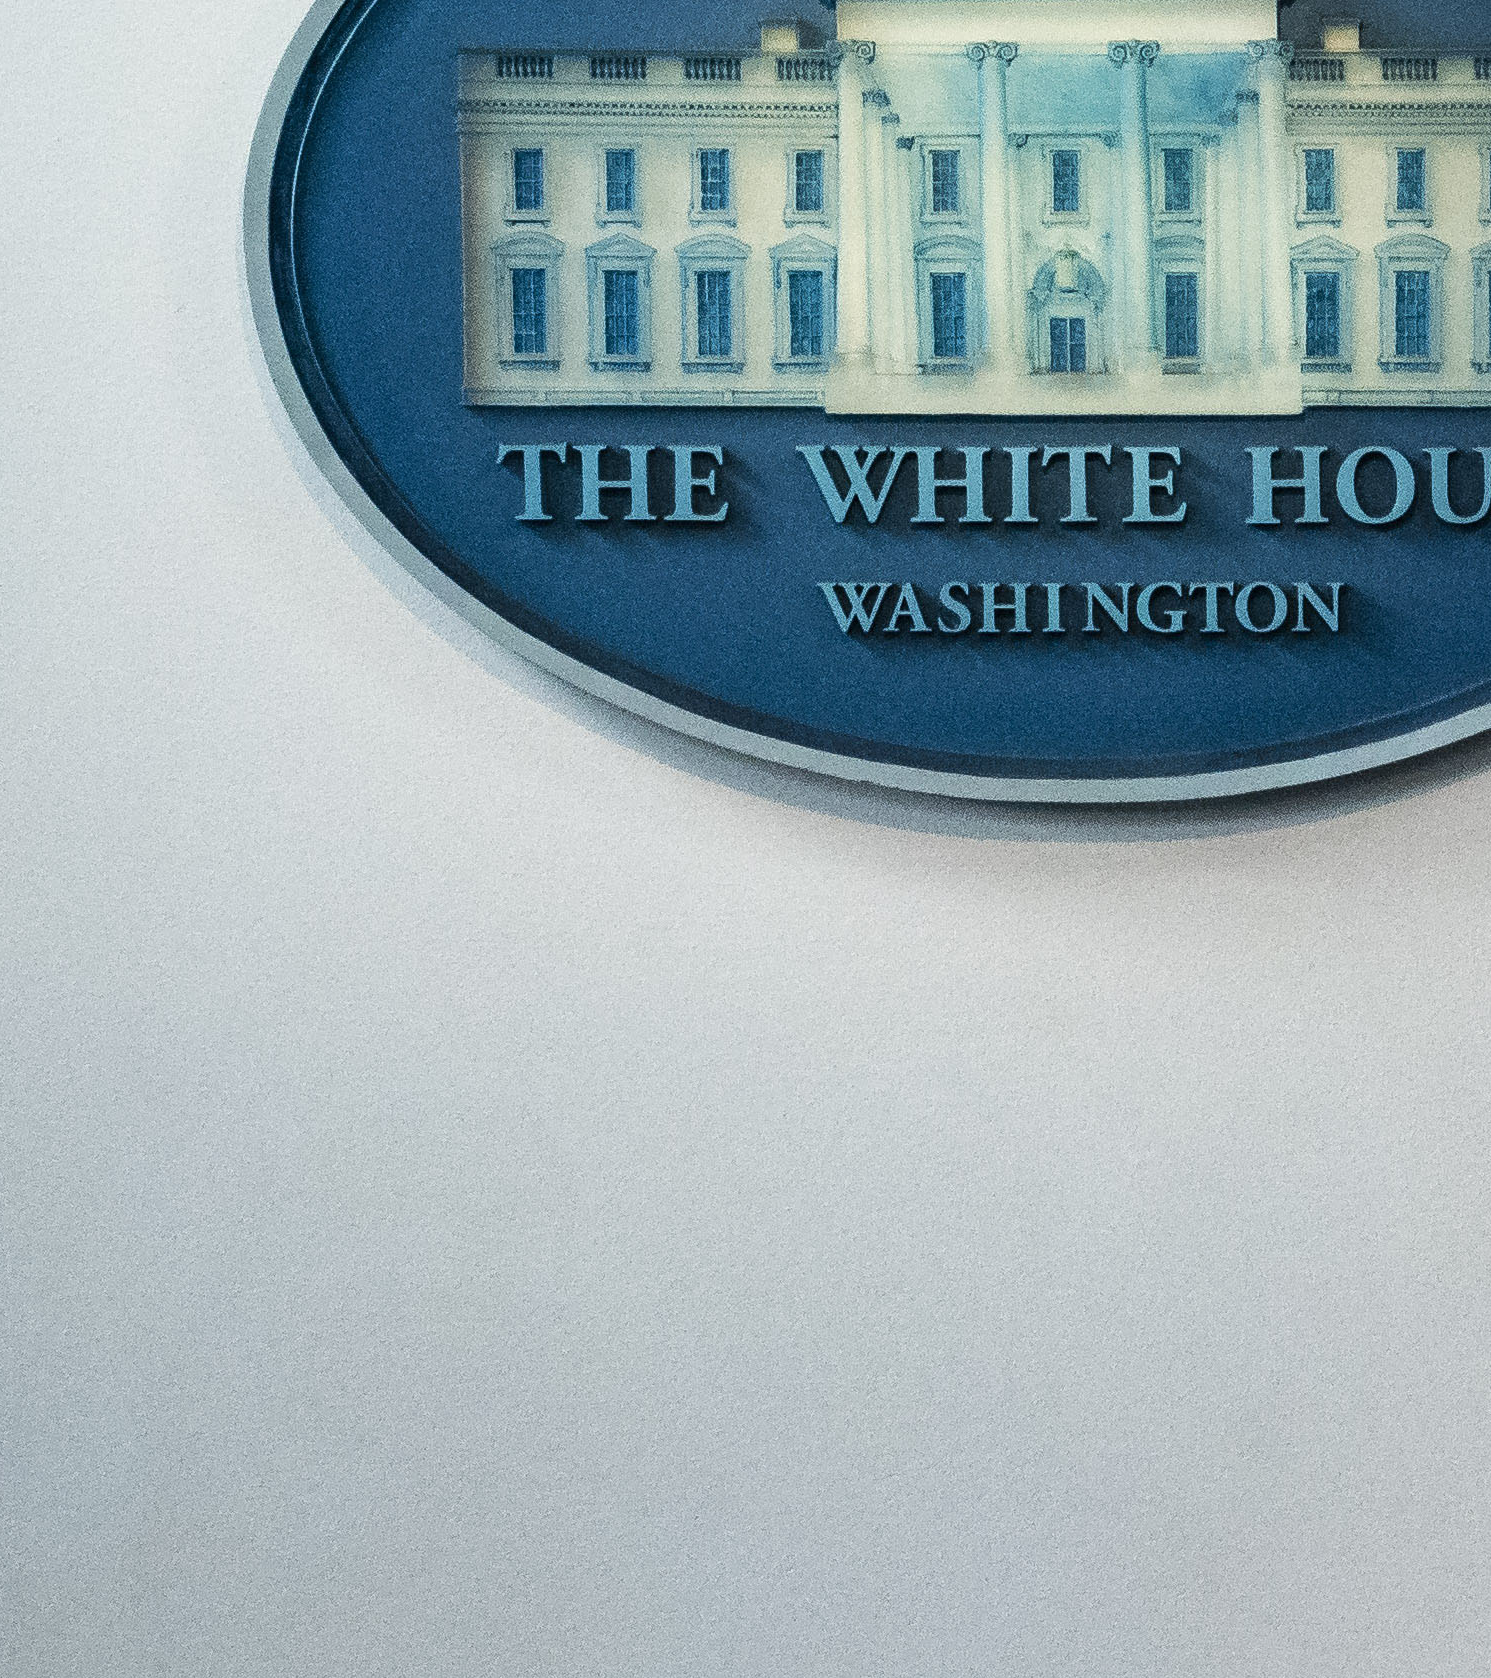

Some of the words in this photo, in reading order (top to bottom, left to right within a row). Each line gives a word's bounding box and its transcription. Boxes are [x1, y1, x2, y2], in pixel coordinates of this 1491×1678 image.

[496, 441, 730, 522] THE
[794, 444, 1189, 525] WHITE
[816, 580, 1347, 634] WASHINGTON
